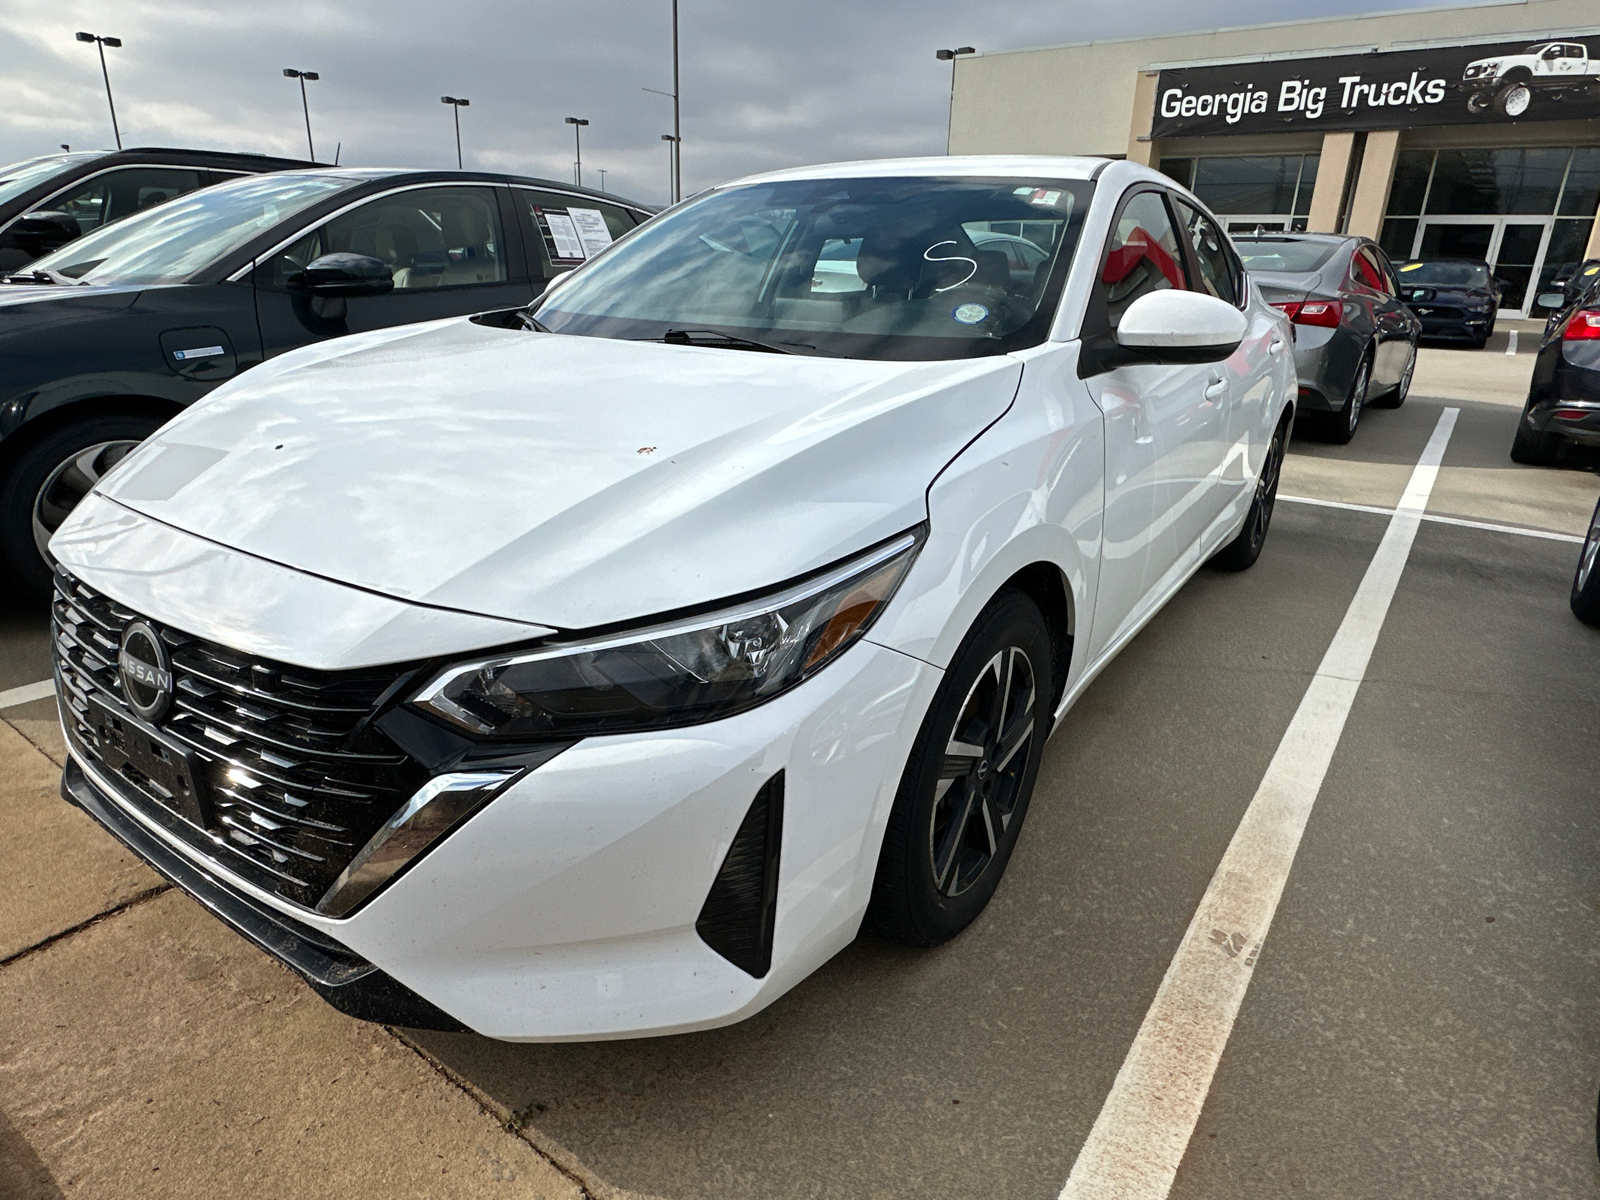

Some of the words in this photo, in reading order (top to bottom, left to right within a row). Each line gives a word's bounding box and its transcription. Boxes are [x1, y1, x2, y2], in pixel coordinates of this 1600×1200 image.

[1161, 84, 1268, 123] Georgia
[1278, 80, 1327, 119] Big
[1338, 72, 1446, 108] Trucks
[923, 240, 978, 292] S
